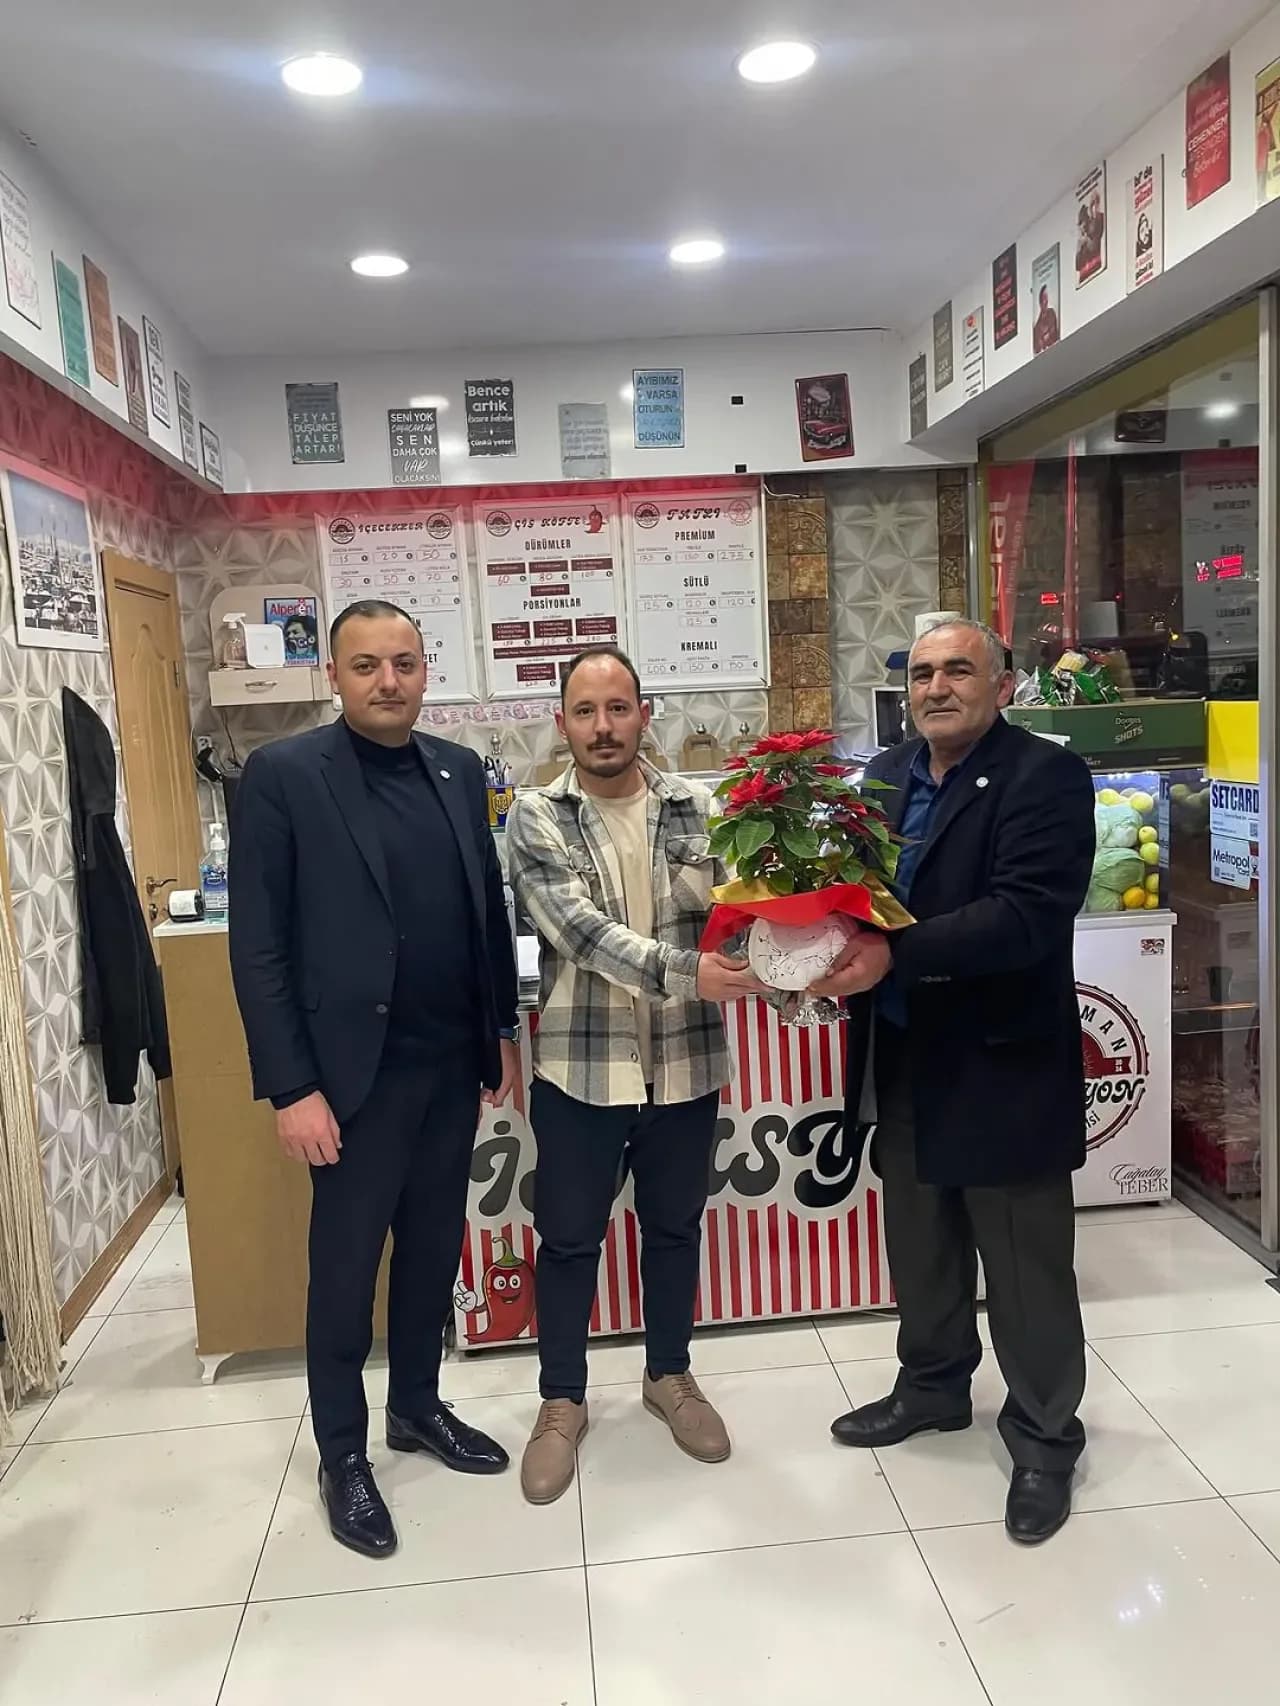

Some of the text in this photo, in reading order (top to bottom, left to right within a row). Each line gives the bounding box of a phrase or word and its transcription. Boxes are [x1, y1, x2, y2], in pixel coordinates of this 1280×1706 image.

[467, 385, 511, 397] Bence
[646, 390, 678, 400] VARSA
[472, 399, 508, 412] artık
[390, 411, 434, 423] SENİ YOK
[295, 434, 338, 444] TALEP
[396, 434, 433, 445] SEN
[393, 447, 438, 458] DAHA ÇOK
[402, 459, 429, 473] VAR
[683, 575, 710, 588] SÜTLÜ
[271, 603, 313, 616] Alperen
[1114, 725, 1144, 744] SHOTS
[1211, 783, 1259, 814] SETCARD
[1213, 847, 1250, 869] Metropol
[1119, 1177, 1169, 1195] TEBER
